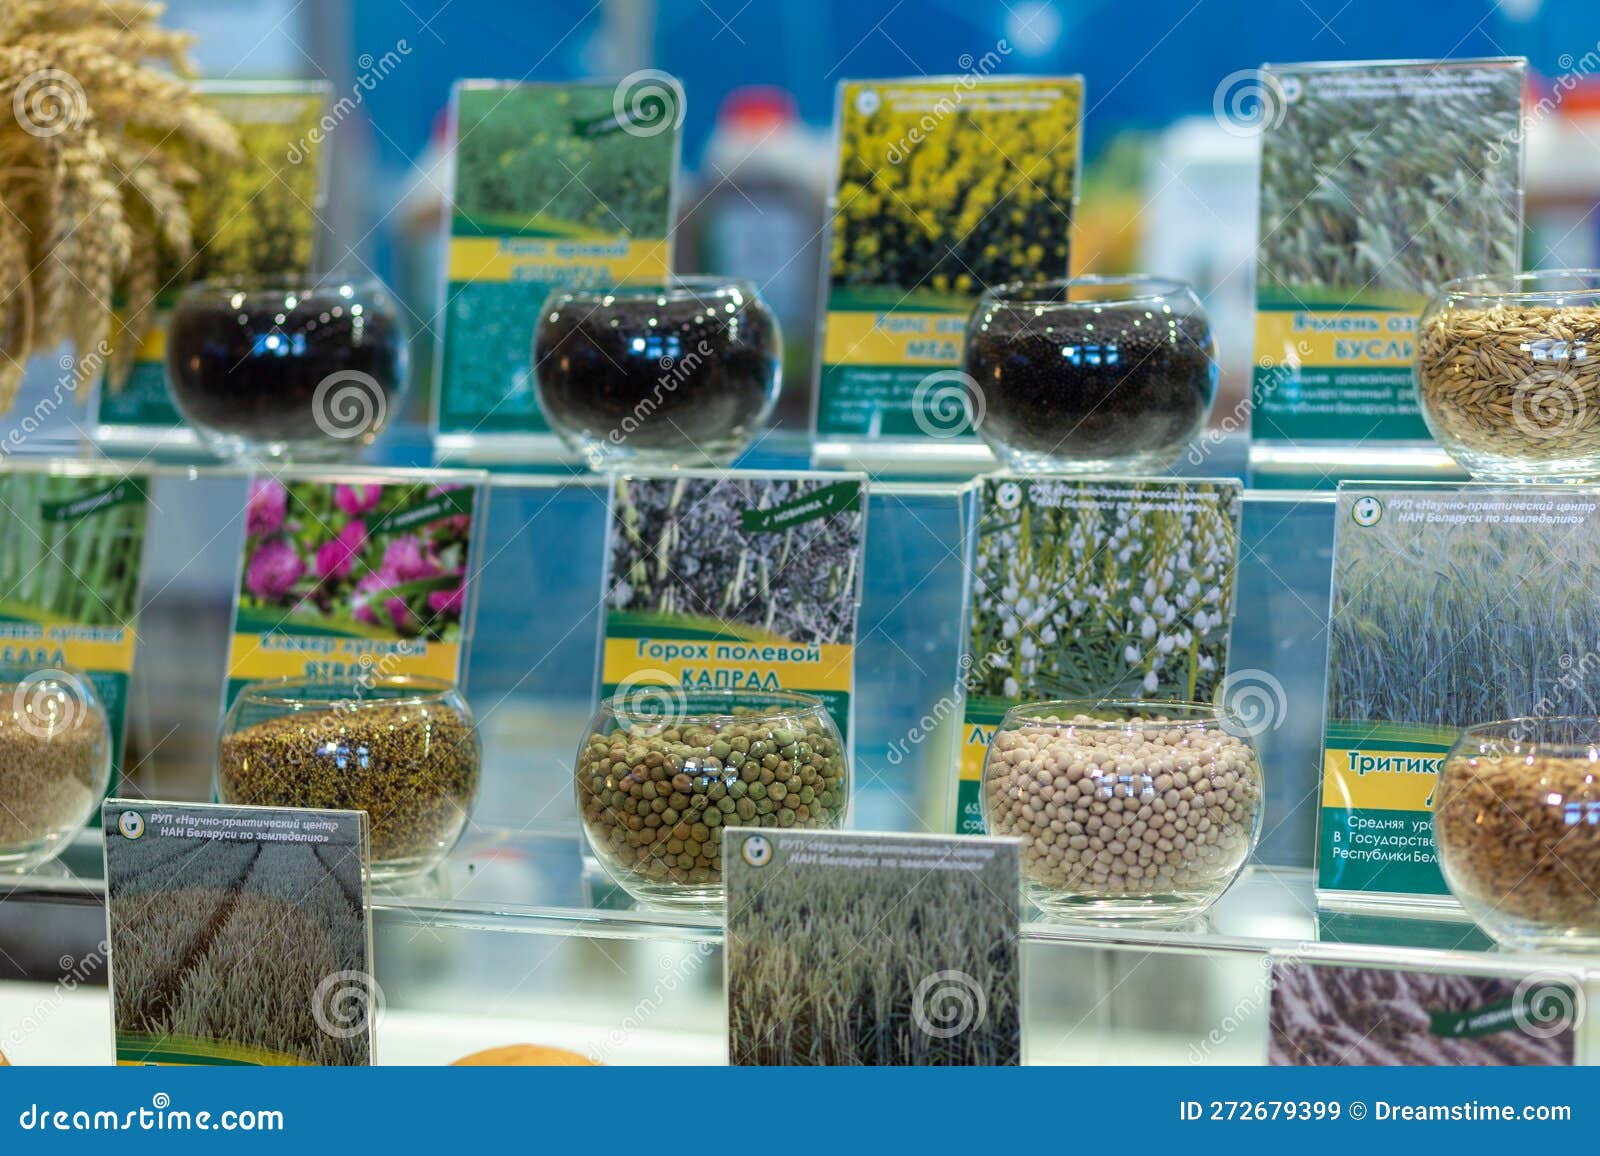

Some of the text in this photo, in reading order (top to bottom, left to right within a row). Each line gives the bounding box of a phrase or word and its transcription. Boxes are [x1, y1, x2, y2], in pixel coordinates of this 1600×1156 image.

[1389, 499, 1596, 513] РУП «Научно-практический центр
[1398, 512, 1584, 525] НАН Беларуси по земледелию»
[637, 639, 820, 663] Горох полевой
[681, 668, 780, 689] КАПРАЛ
[151, 813, 339, 833] РУП «Научно-практический центр
[1347, 815, 1404, 829] Средняя
[160, 826, 329, 843] НАН Беларуси по земледелию»
[1333, 831, 1341, 842] В
[1332, 847, 1411, 862] Республики
